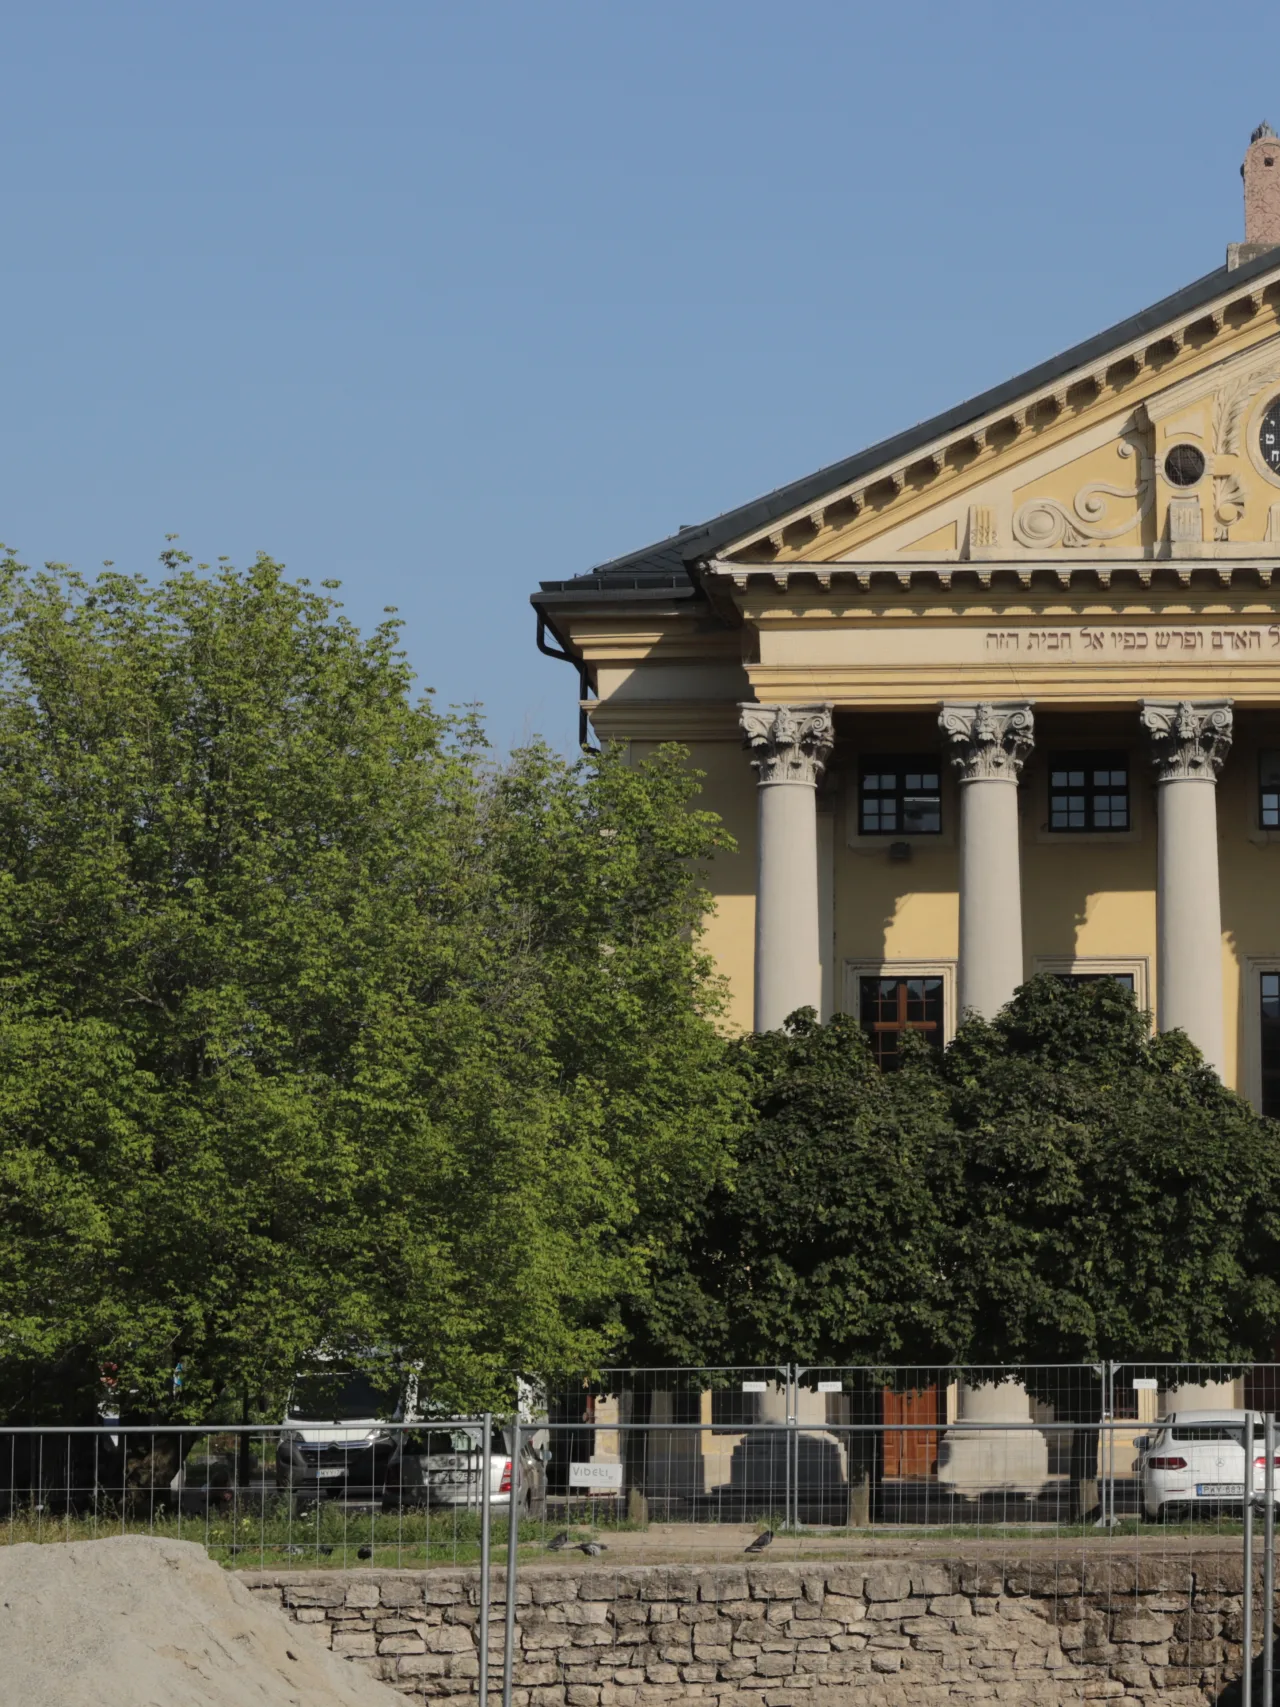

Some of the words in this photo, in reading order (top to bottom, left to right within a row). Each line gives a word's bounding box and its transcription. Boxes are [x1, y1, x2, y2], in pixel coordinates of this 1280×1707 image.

[1265, 434, 1275, 445] ט
[1271, 450, 1280, 462] ח
[986, 632, 1019, 650] הזה
[1027, 632, 1071, 651] הבית
[1080, 627, 1104, 650] אל
[1110, 632, 1149, 651] כפיו
[1155, 630, 1204, 650] ופרש
[1210, 630, 1261, 650] האדם
